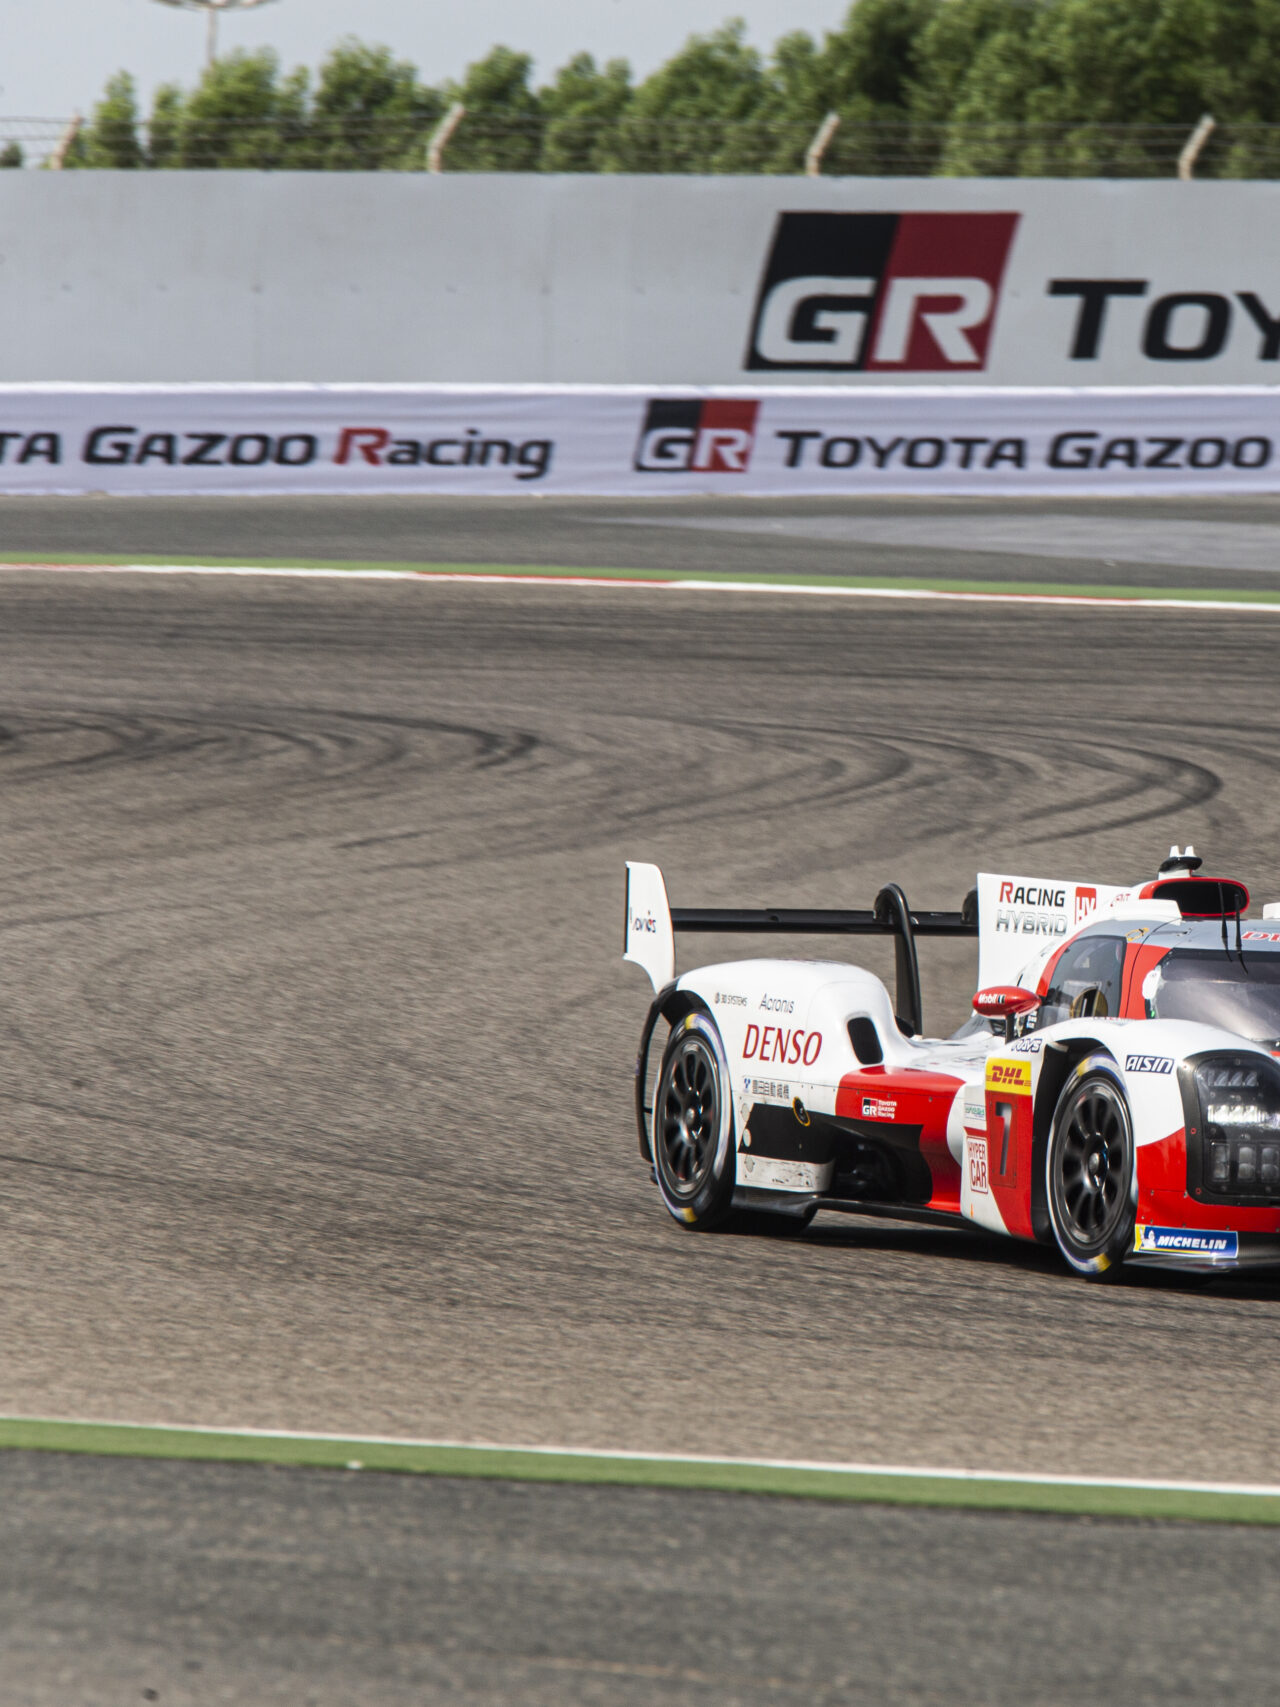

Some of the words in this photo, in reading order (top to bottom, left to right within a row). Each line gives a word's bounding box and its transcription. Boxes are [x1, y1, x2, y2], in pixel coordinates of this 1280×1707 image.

[755, 274, 997, 364] GR
[81, 425, 320, 467] GAZOO
[332, 427, 555, 480] Racing
[641, 427, 749, 469] GR
[774, 429, 1028, 470] TOYOTA
[1045, 430, 1274, 470] GAZOO
[999, 881, 1066, 907] RACING
[995, 909, 1068, 937] HYBRID
[759, 993, 795, 1014] Acronis
[978, 993, 997, 1004] Mobil
[742, 1023, 823, 1067] DENSO
[991, 1065, 1025, 1086] DHL
[1126, 1055, 1173, 1074] AISIN
[967, 1141, 986, 1160] HYPER
[995, 1101, 1013, 1176] 7
[970, 1159, 987, 1189] CAR
[1157, 1235, 1227, 1250] MICHELIN
